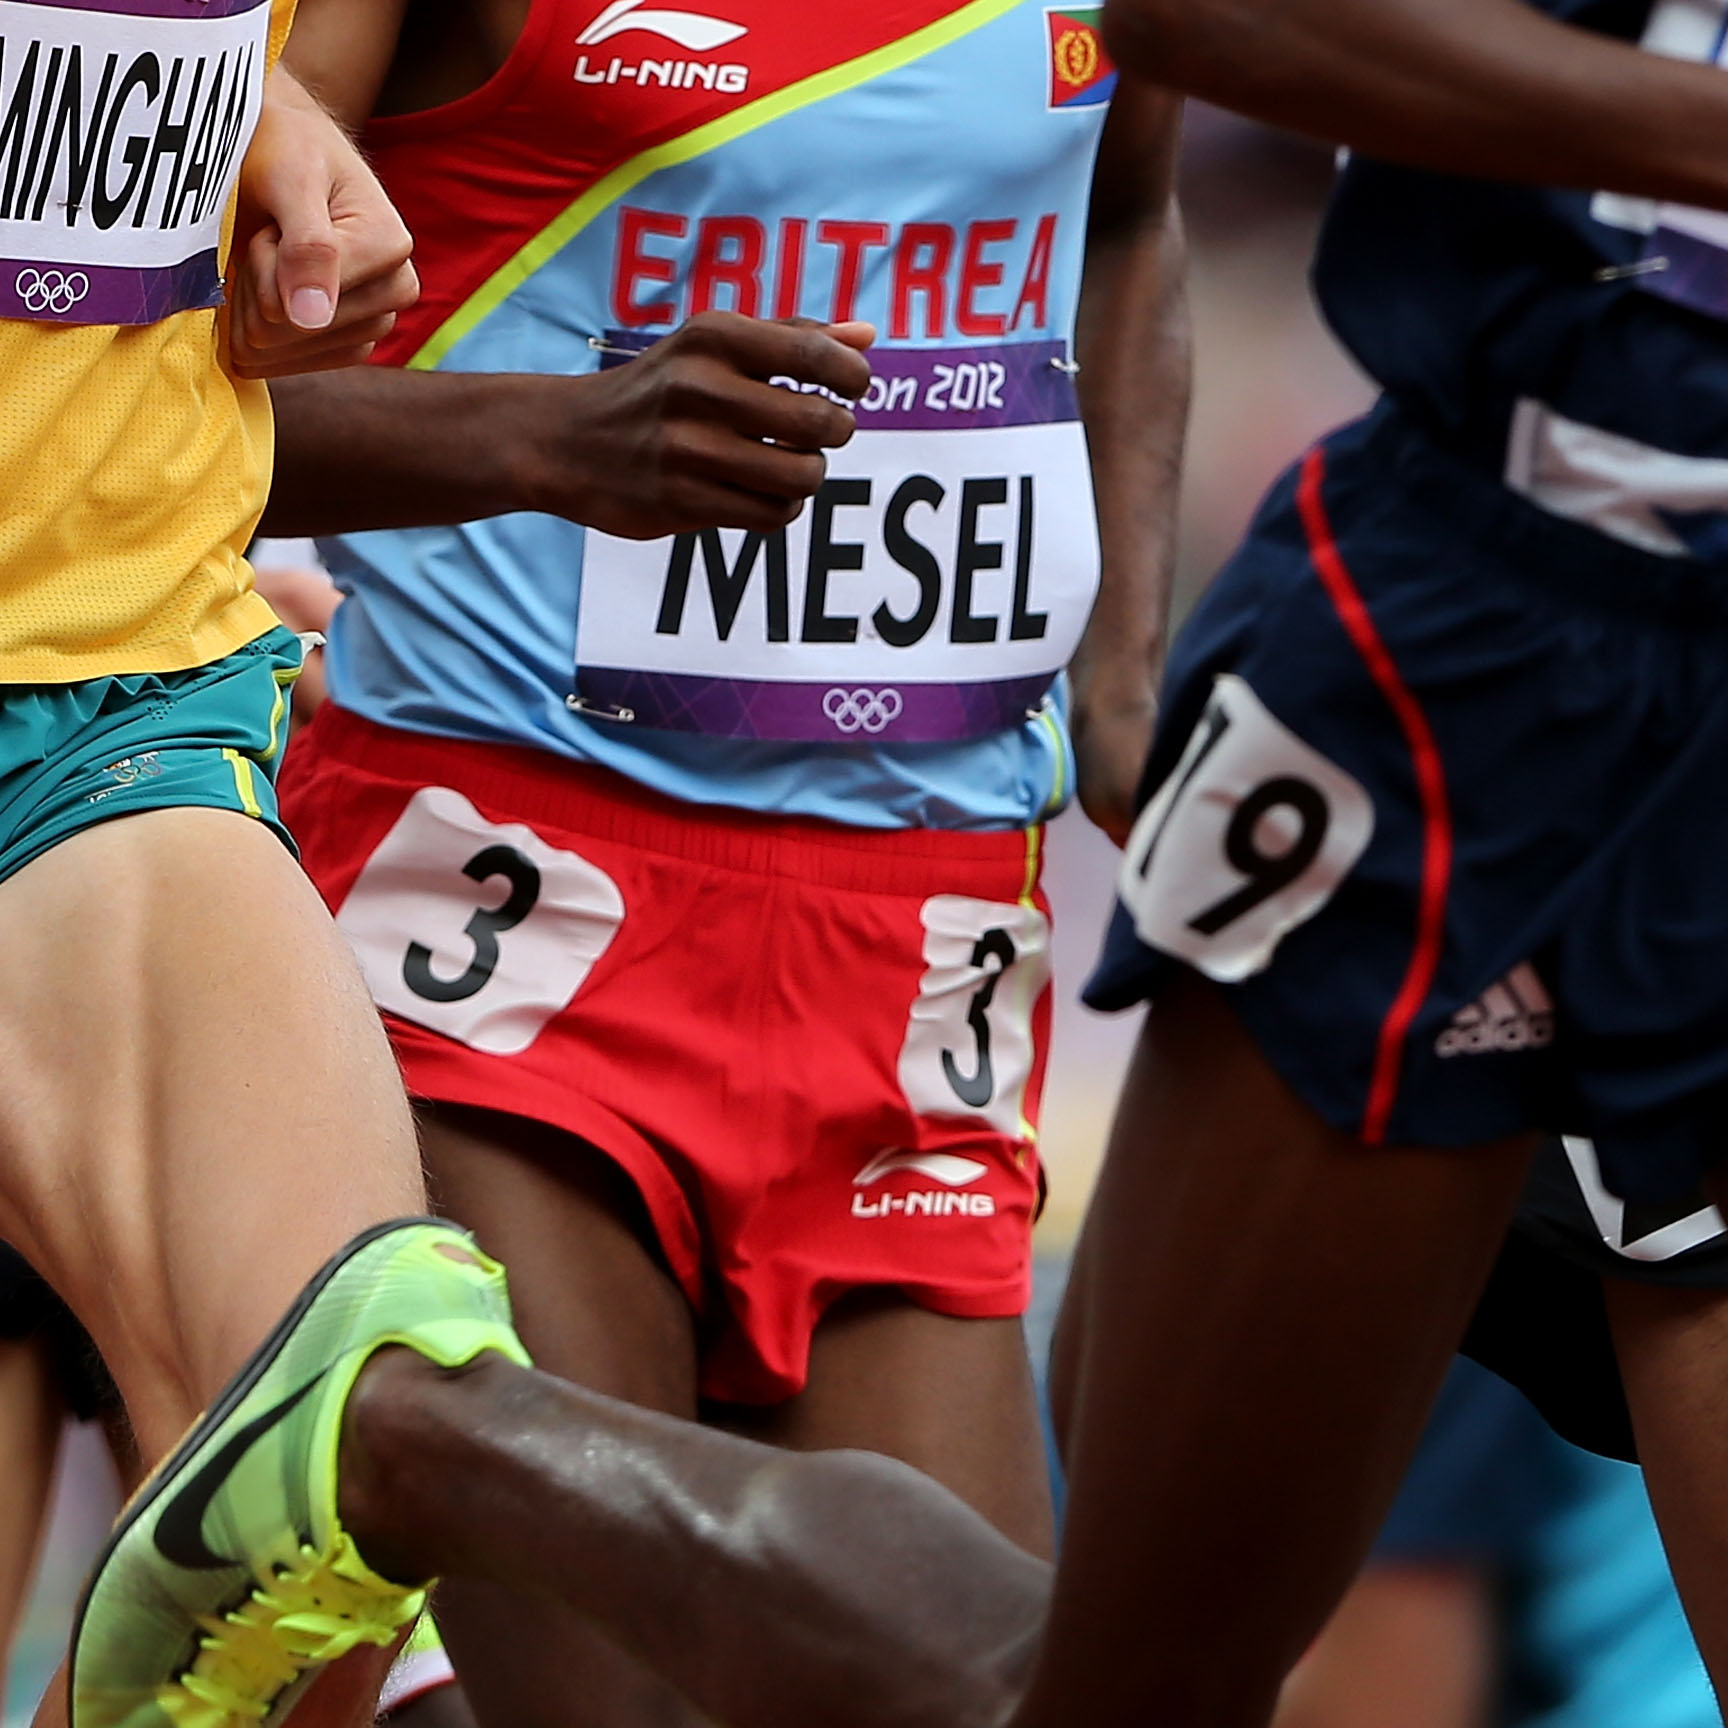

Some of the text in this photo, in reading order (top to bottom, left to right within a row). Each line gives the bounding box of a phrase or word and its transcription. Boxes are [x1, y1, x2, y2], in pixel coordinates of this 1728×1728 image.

[574, 55, 749, 94] LI-NING
[610, 206, 1059, 341] ERITREA
[925, 361, 1006, 411] 2012
[655, 474, 1048, 647] MESEL
[1139, 704, 1330, 939] 19
[402, 843, 542, 1004] 3
[941, 928, 1015, 1108] 3
[852, 1192, 995, 1220] LI-NING
